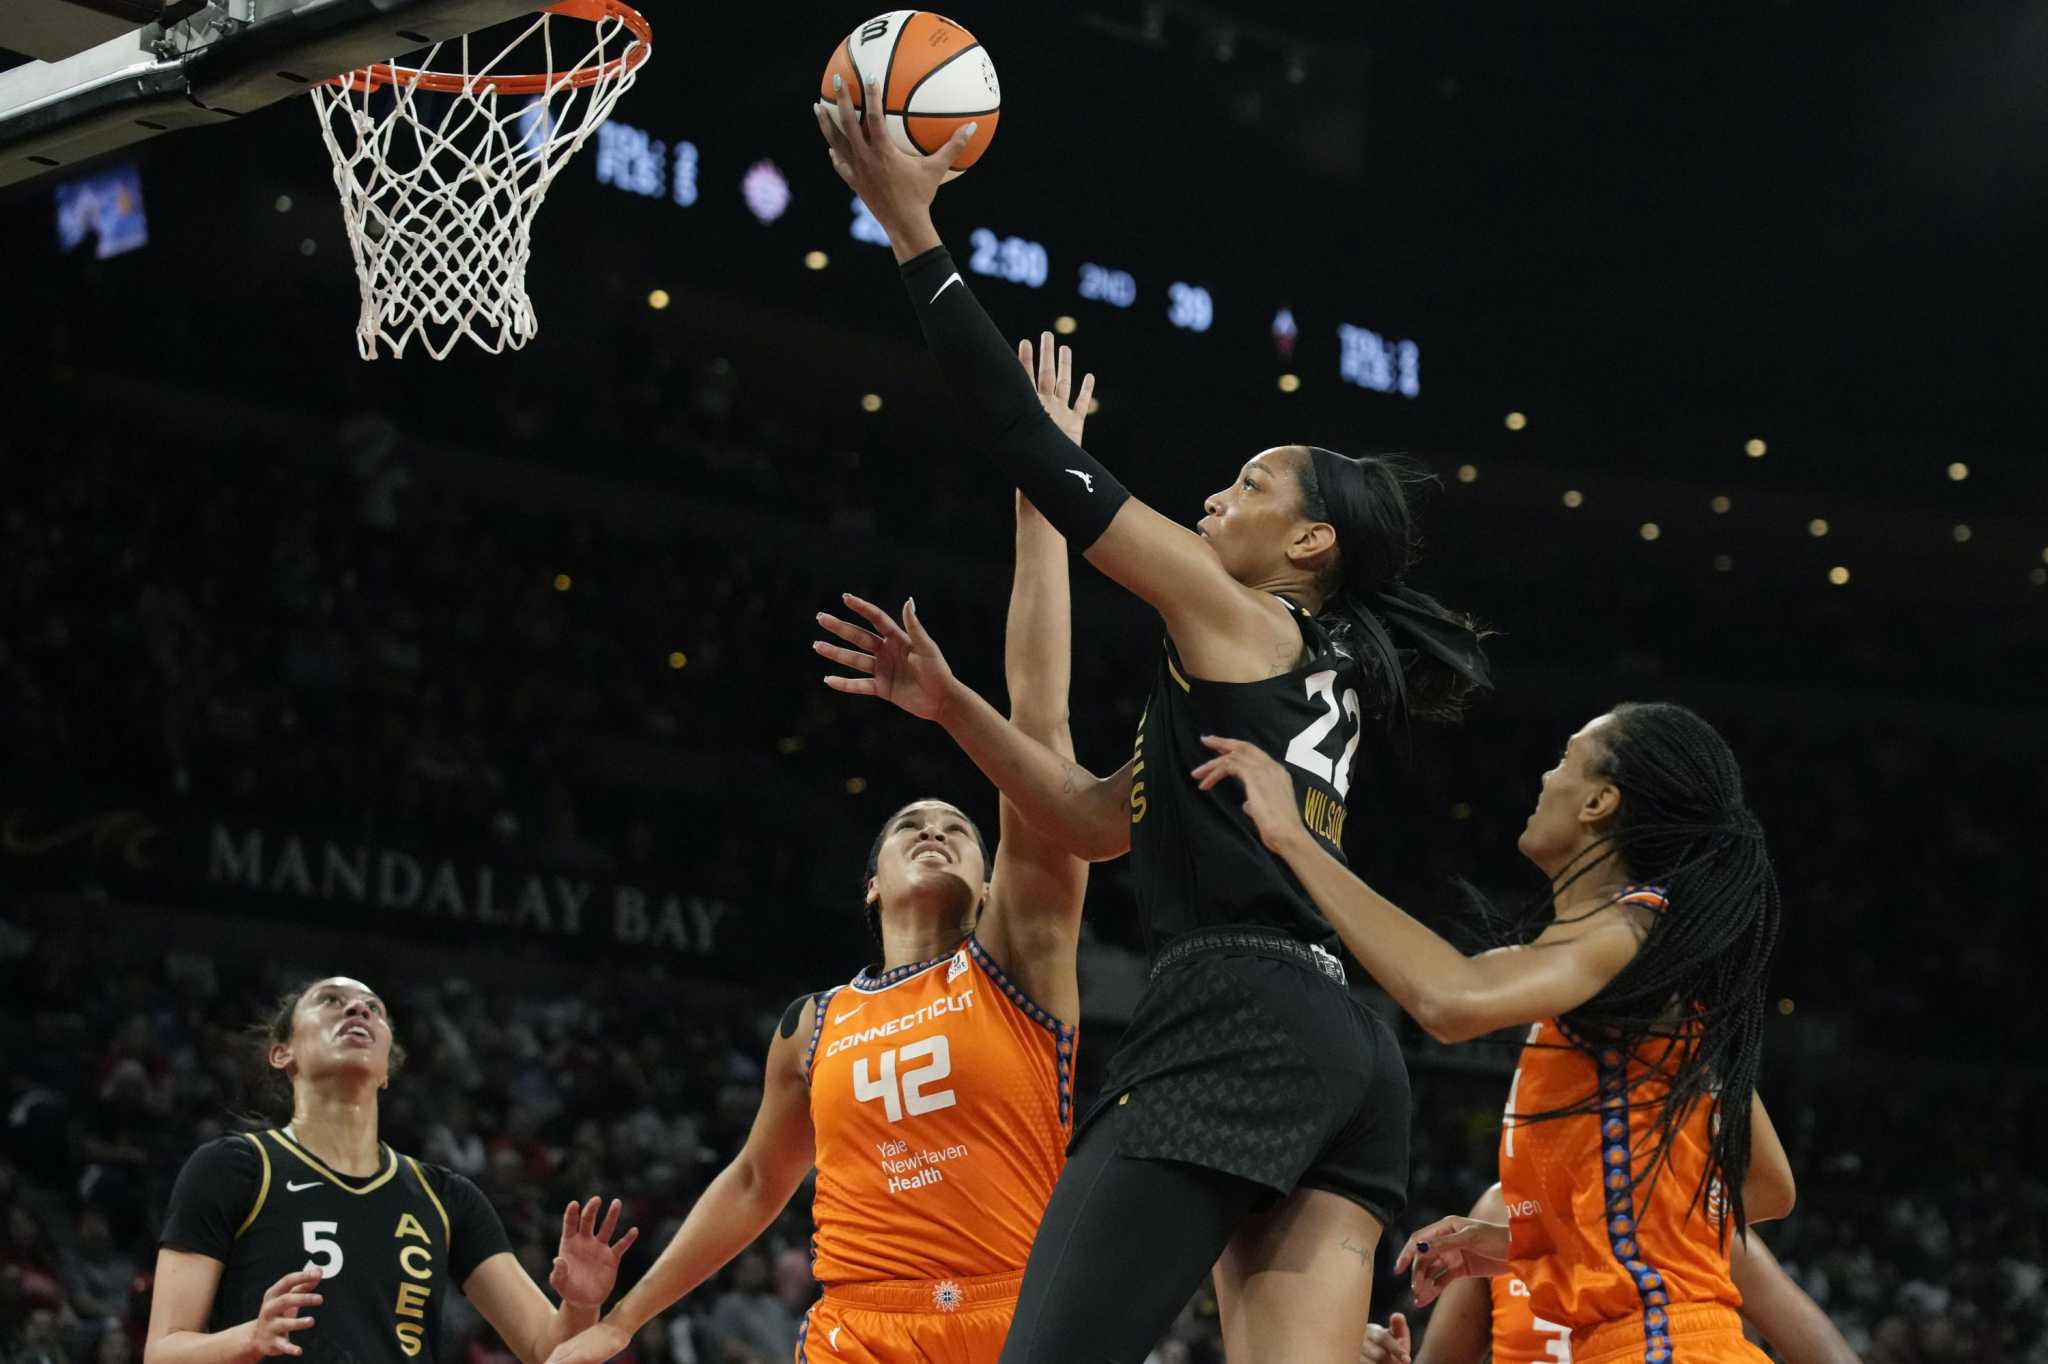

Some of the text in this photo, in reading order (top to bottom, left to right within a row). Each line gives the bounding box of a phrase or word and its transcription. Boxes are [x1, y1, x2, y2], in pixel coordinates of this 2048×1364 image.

[208, 824, 727, 952] MANDALAY BAY
[826, 990, 975, 1057] CONNECTICUT
[853, 1035, 956, 1123] 42
[876, 1139, 908, 1158] Yale
[881, 1144, 968, 1174] NewHaven
[888, 1167, 943, 1194] Health
[302, 1221, 344, 1279] 5
[394, 1213, 433, 1357] ACES
